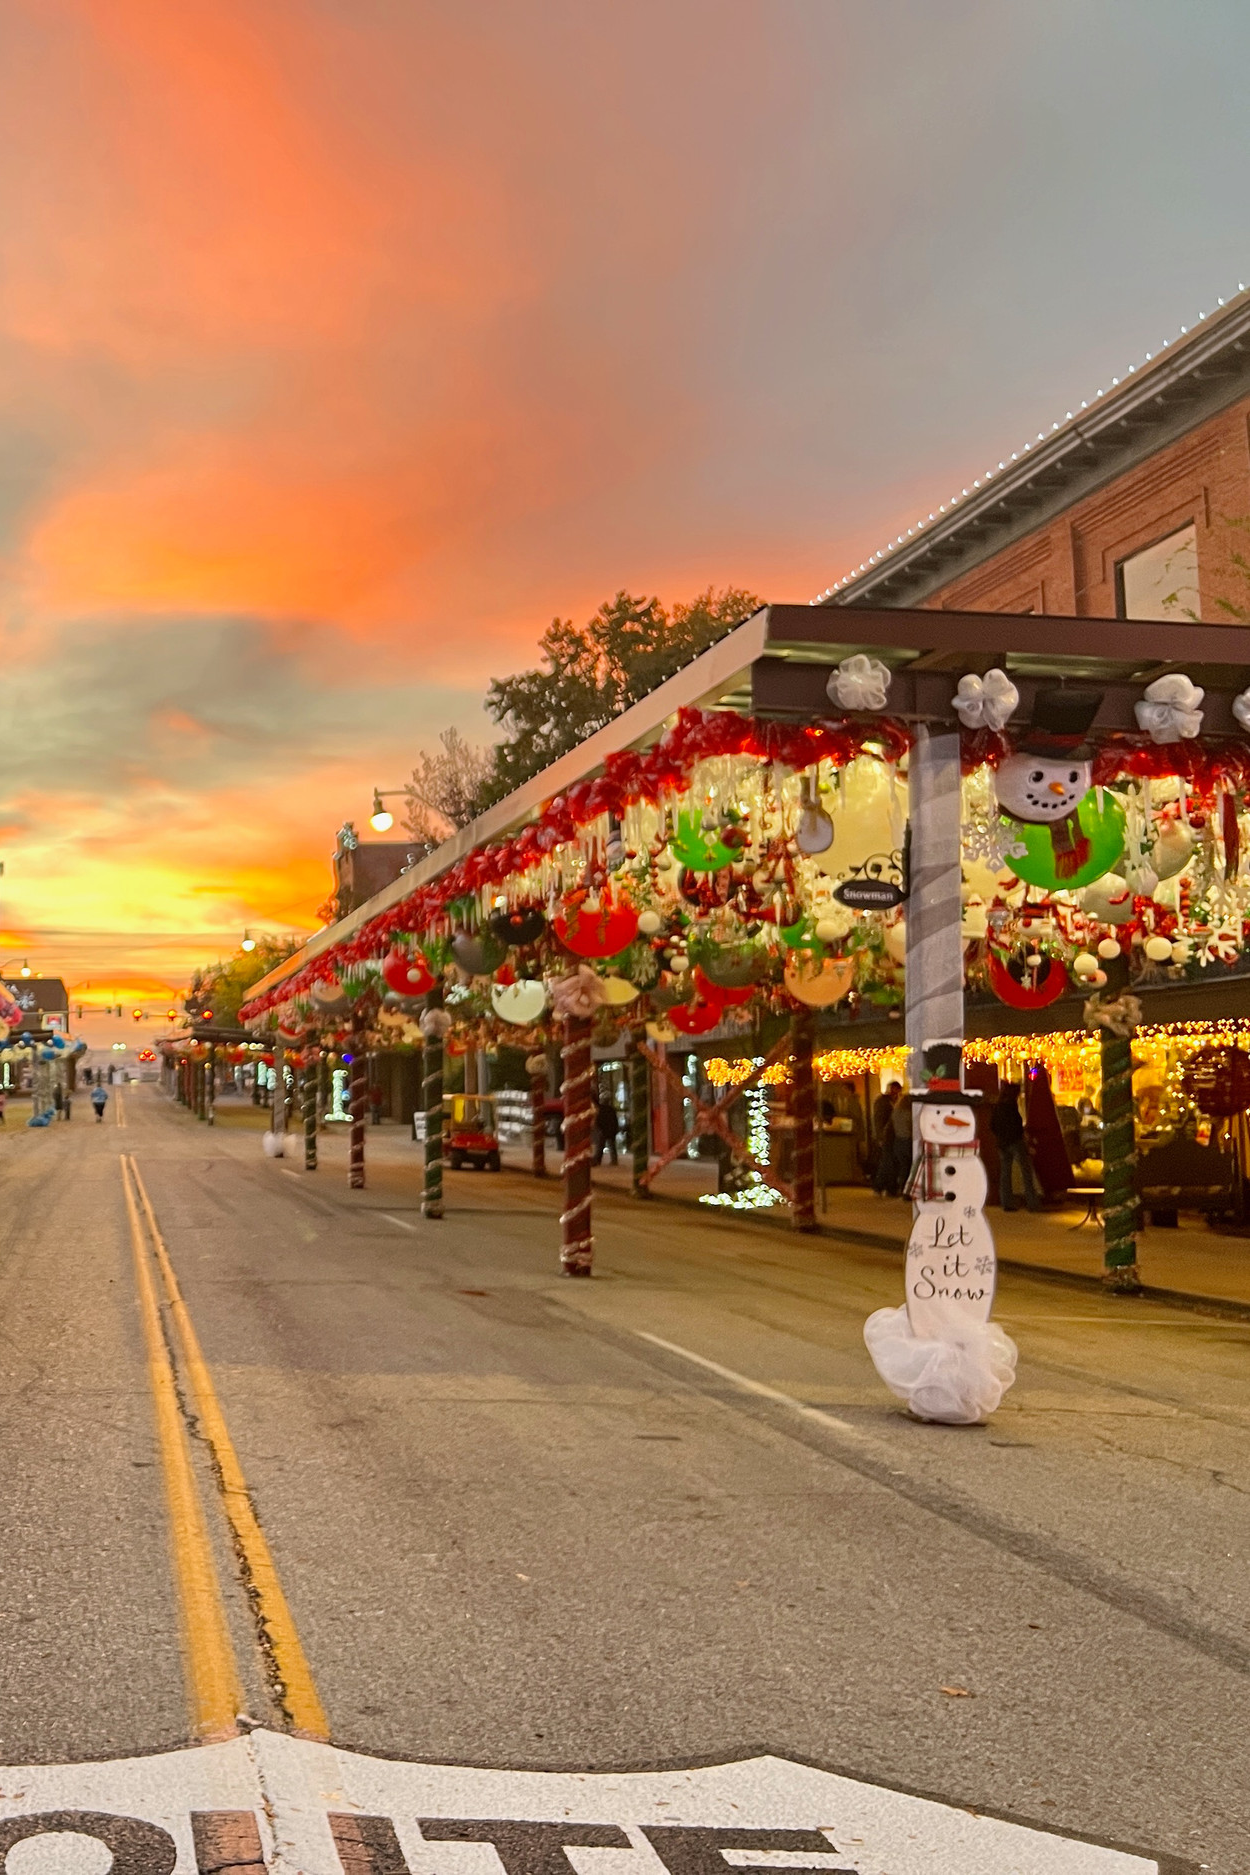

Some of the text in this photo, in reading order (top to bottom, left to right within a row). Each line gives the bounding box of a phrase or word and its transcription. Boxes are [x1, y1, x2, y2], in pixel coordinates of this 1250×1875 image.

[843, 887, 894, 902] Snowman
[928, 1216, 974, 1249] Let
[943, 1253, 970, 1278] it
[913, 1265, 990, 1300] Snow
